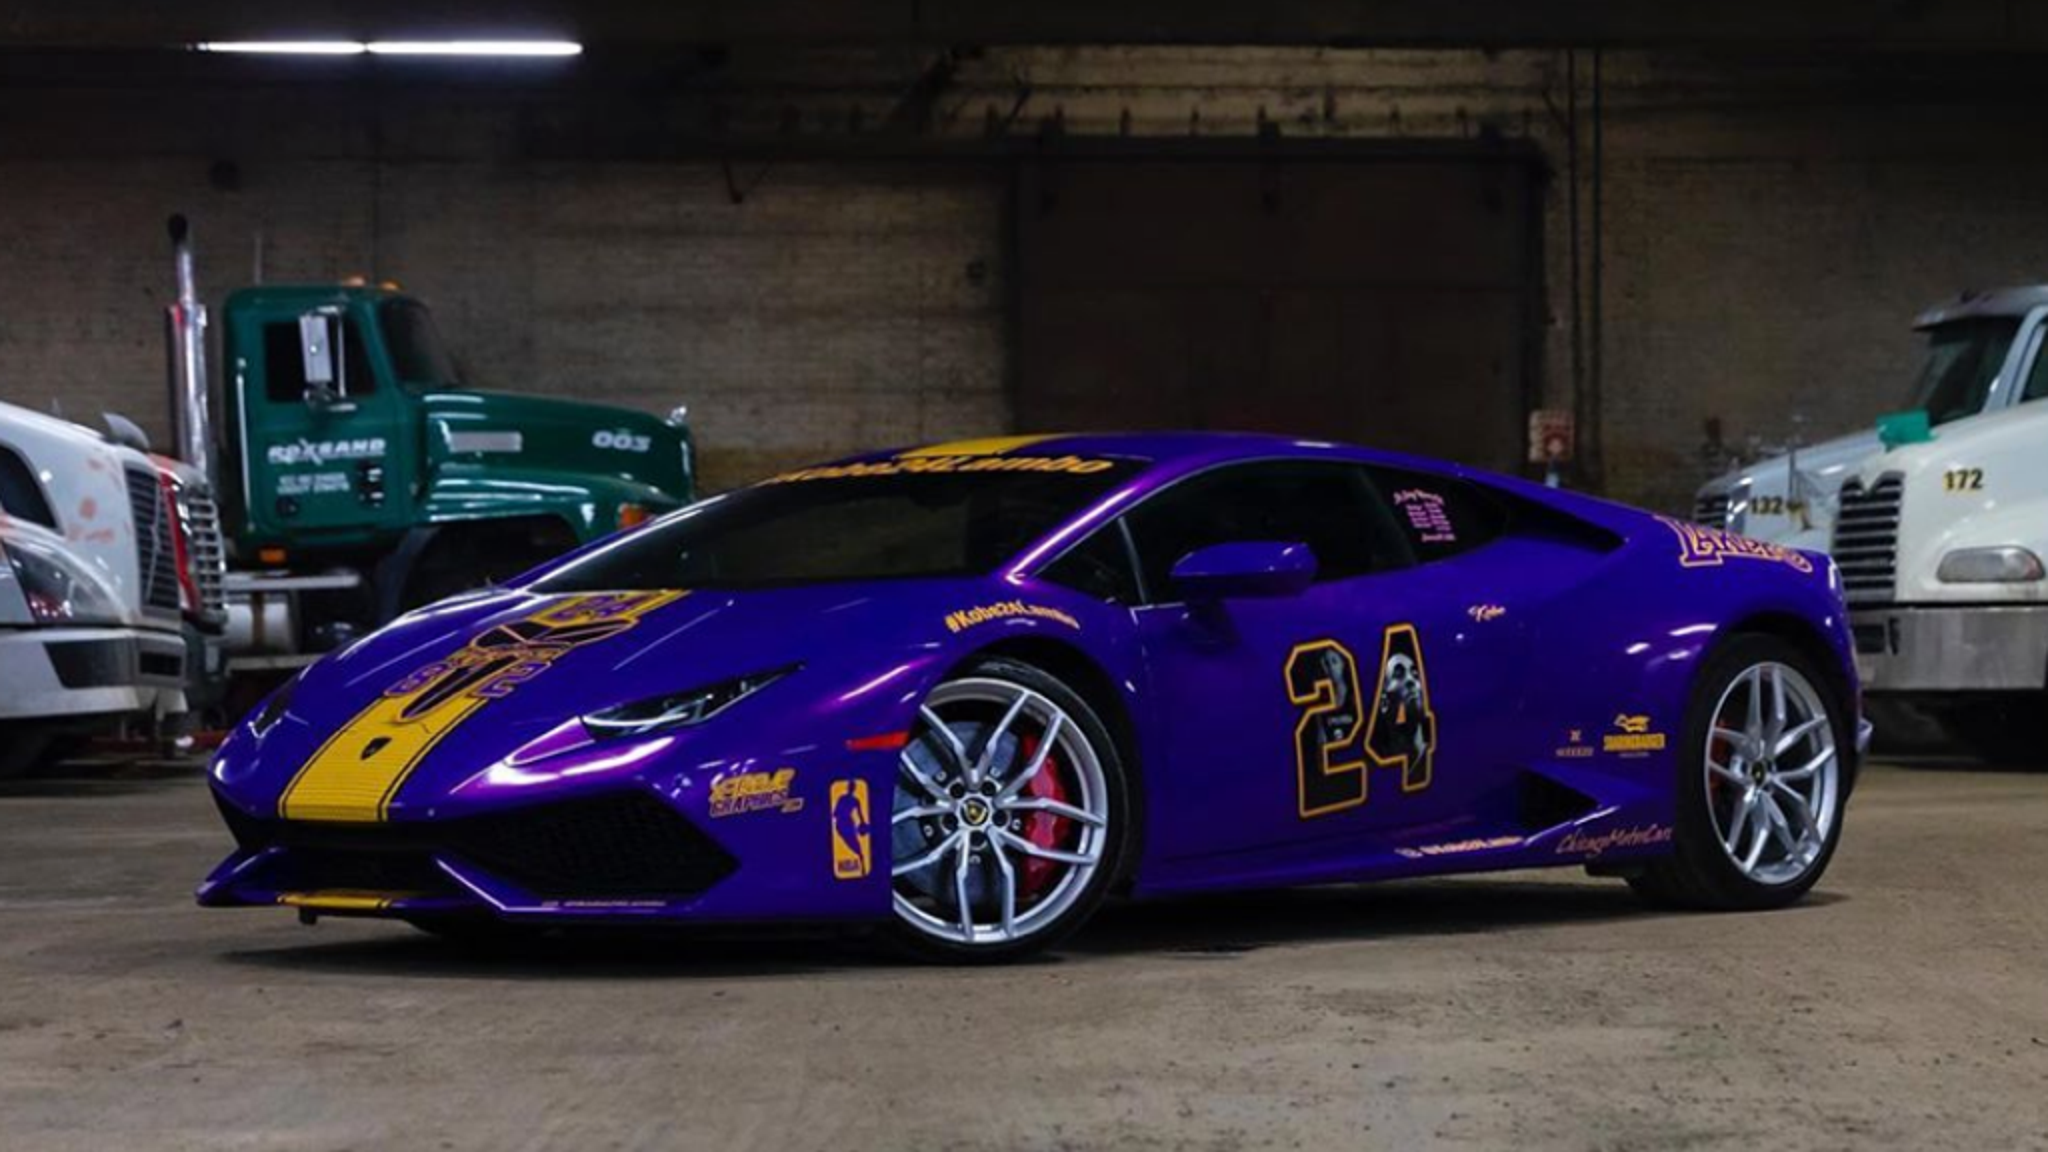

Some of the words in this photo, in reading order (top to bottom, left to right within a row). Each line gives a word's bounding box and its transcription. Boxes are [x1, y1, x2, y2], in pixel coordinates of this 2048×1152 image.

[1943, 468, 1985, 492] 172
[1750, 495, 1784, 515] 132
[1285, 623, 1437, 819] 24
